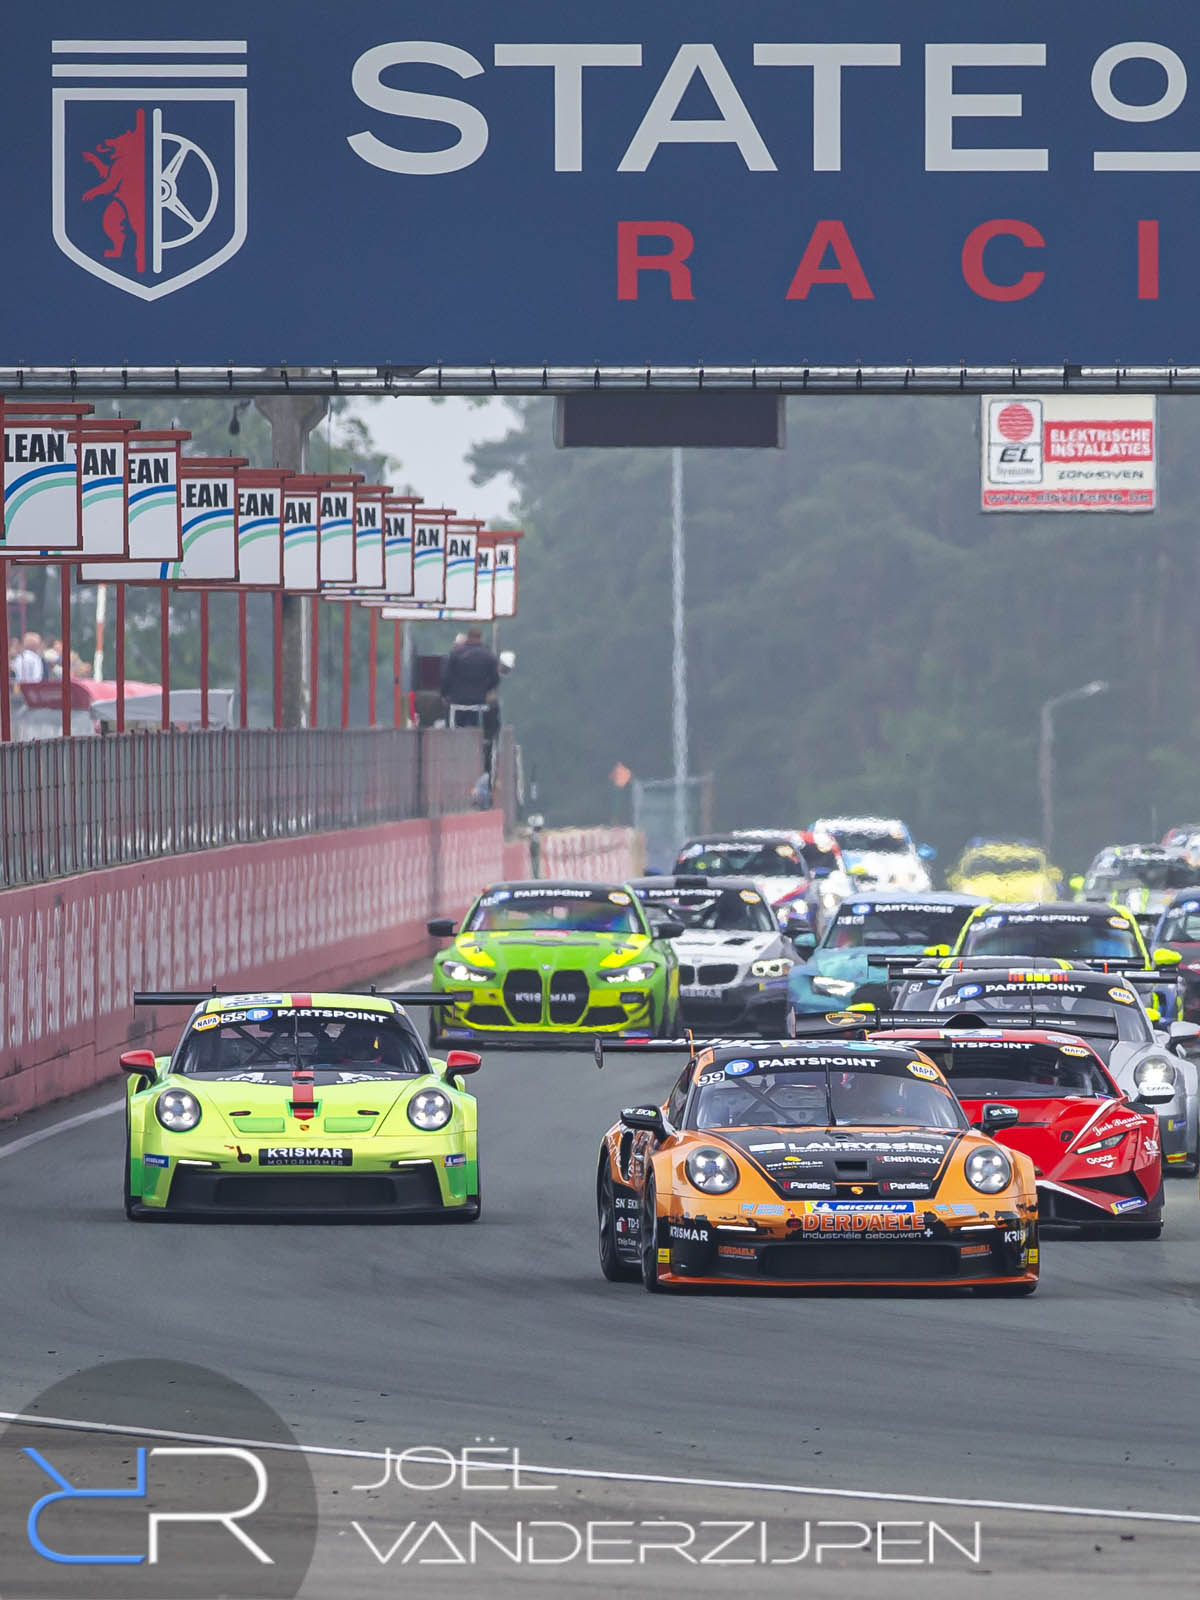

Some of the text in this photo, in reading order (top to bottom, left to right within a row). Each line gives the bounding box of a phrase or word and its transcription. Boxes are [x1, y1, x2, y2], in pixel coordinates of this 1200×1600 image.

[347, 41, 1050, 175] STATE
[1050, 428, 1151, 443] ELEKTRISCHE
[999, 447, 1034, 463] EL
[1050, 443, 1151, 457] INSTALLATIES
[985, 983, 1086, 993] PARTSPOINT
[196, 1018, 218, 1028] NAPA
[221, 1012, 246, 1023] 55
[277, 1009, 389, 1023] PARTSPOINT
[757, 1057, 881, 1069] PARTSPOINT
[911, 1063, 935, 1077] NAPA
[267, 1148, 344, 1158] KRISMAR
[789, 1142, 945, 1152] LAURYSSEN
[889, 1181, 930, 1190] Parallels
[835, 1203, 908, 1212] MICHELIN
[802, 1213, 926, 1232] DERDAELE
